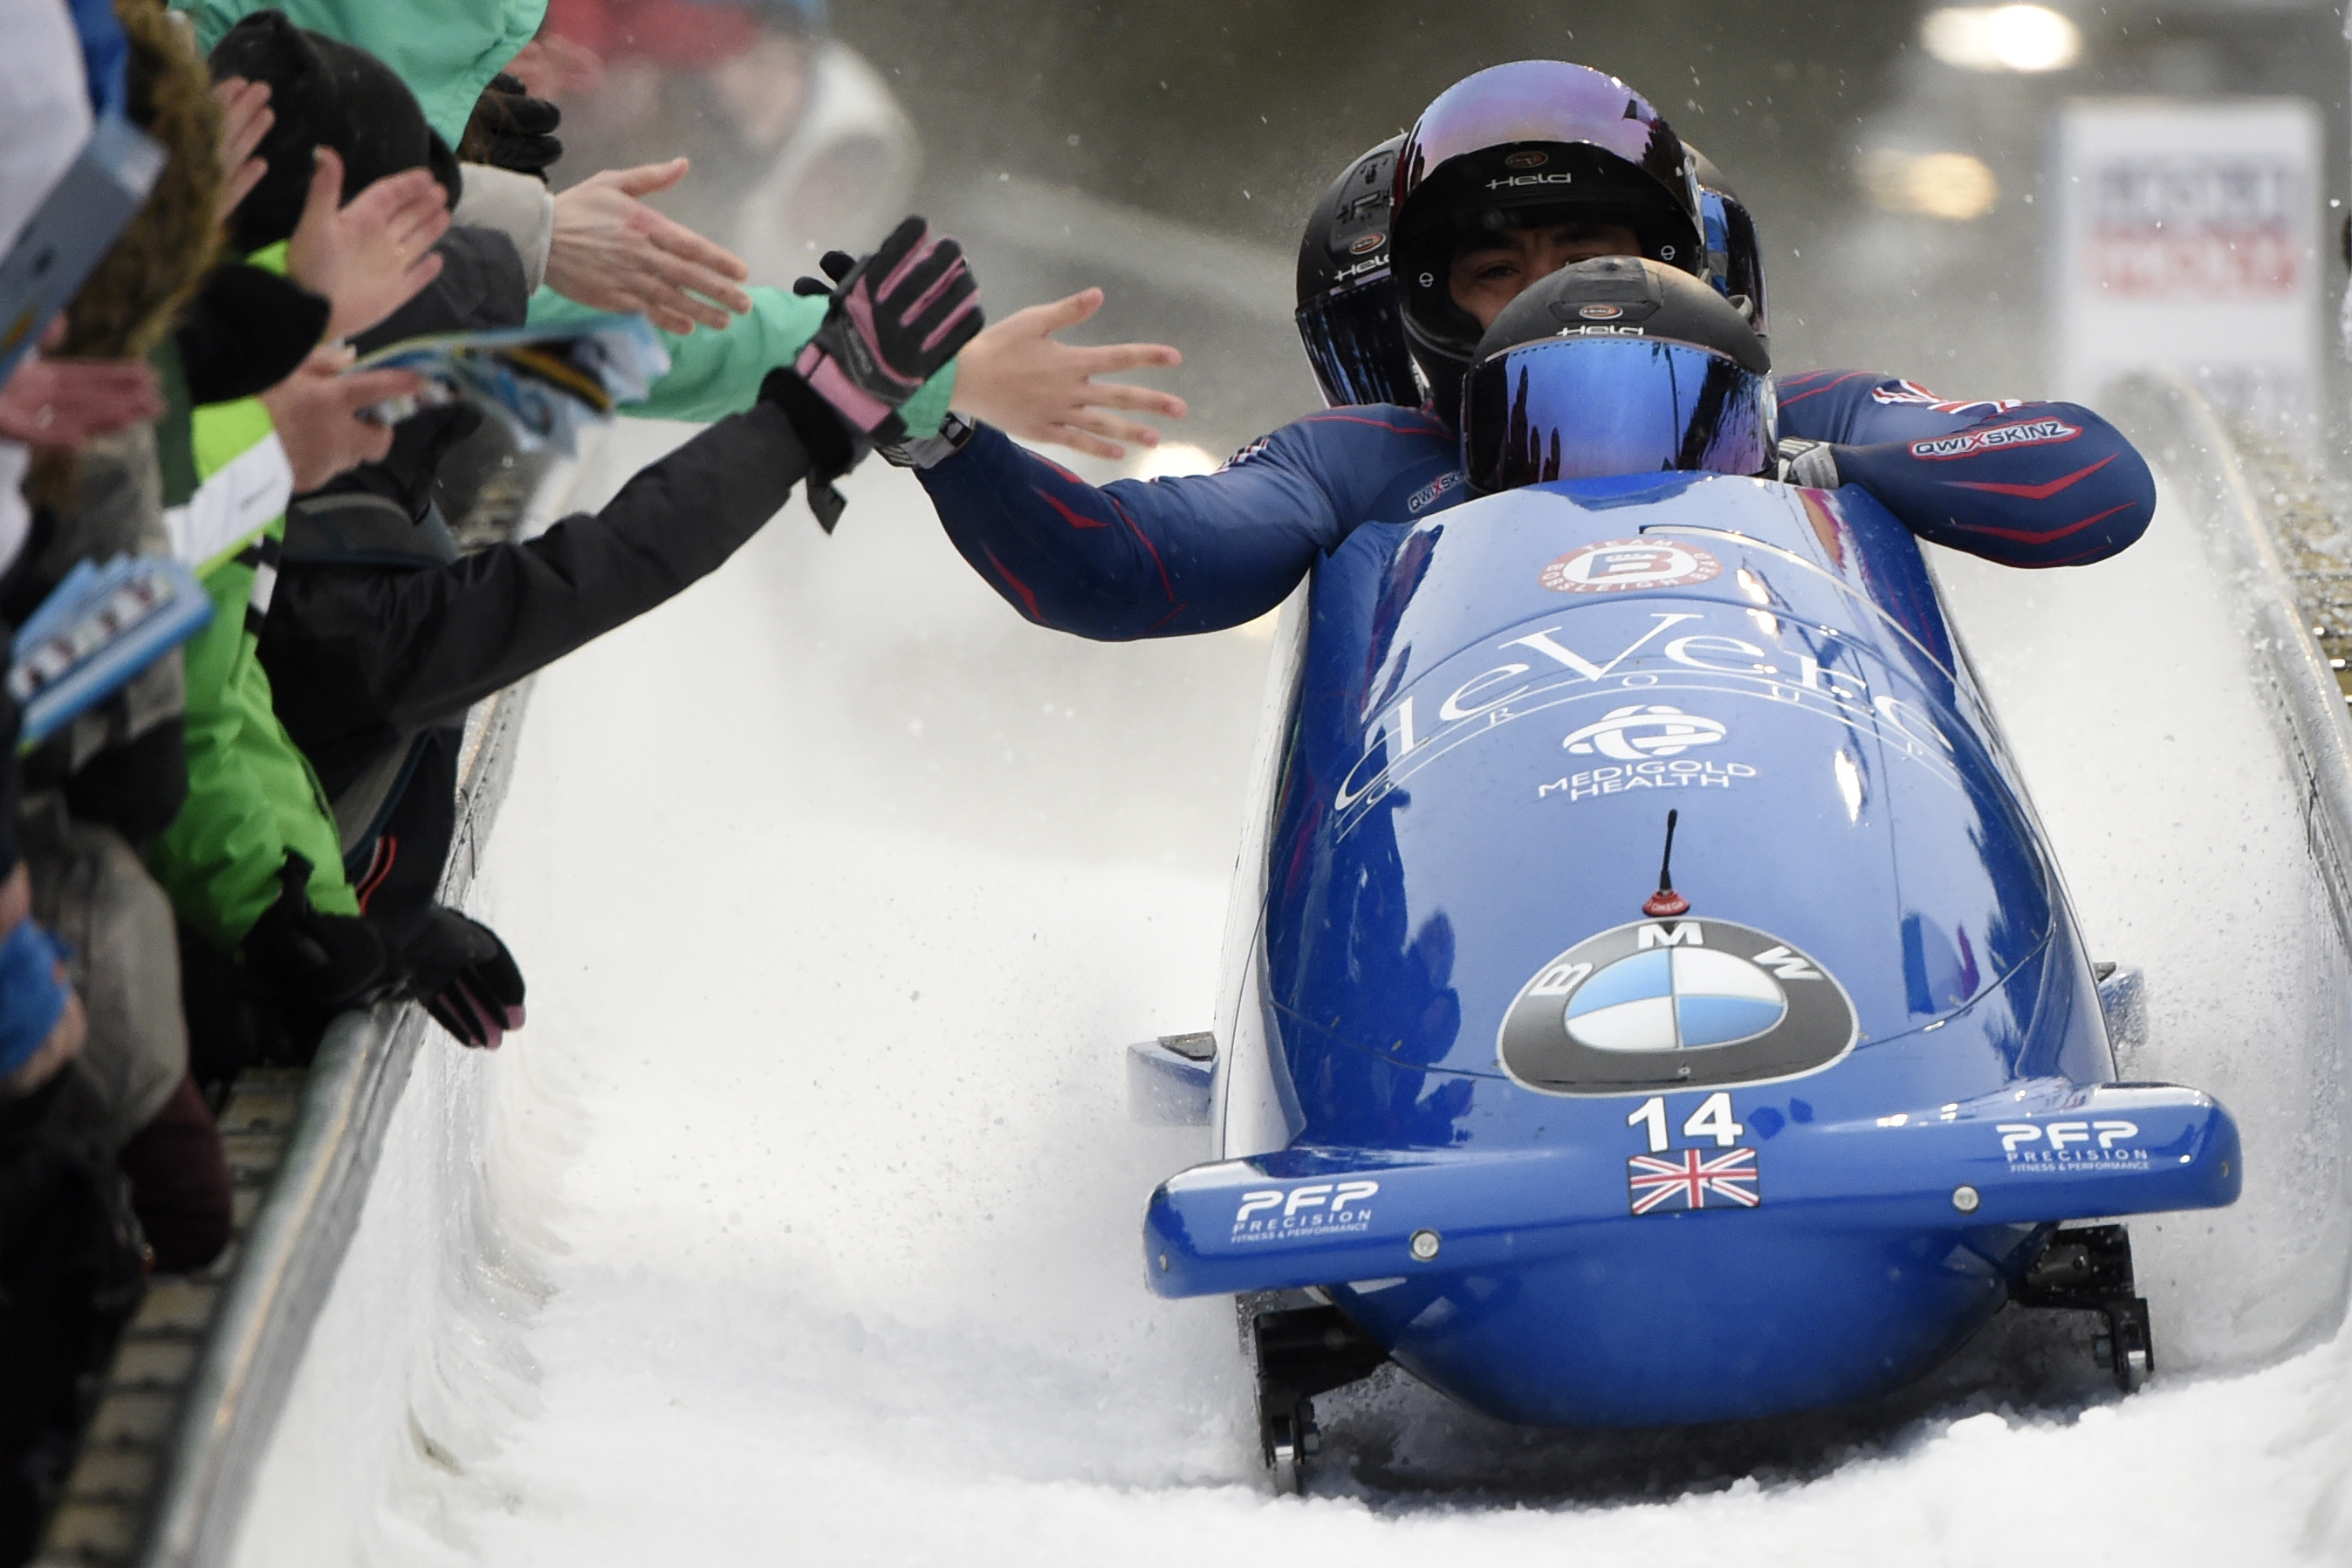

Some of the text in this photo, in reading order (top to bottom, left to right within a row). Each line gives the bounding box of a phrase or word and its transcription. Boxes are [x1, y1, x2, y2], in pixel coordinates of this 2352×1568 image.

[1485, 173, 1571, 189] Held
[1556, 325, 1644, 337] Held
[1916, 422, 2067, 455] QWIXSKINZ
[1584, 538, 1674, 551] TEAM
[1539, 759, 1757, 798] MEDIGOLD
[1571, 773, 1730, 802] HEALTH
[1528, 921, 1825, 996] BMW
[1627, 1092, 1744, 1153] 14
[1996, 1120, 2138, 1151] PFP
[2007, 1148, 2149, 1163] PRECISION
[2011, 1162, 2056, 1173] FITNESS
[2068, 1161, 2150, 1171] PERFORMANCE
[1236, 1180, 1380, 1222] PFP
[1231, 1230, 1276, 1243] FITNESS
[1287, 1222, 1368, 1237] PERFORMANCE
[1232, 1209, 1373, 1235] PRECISION
